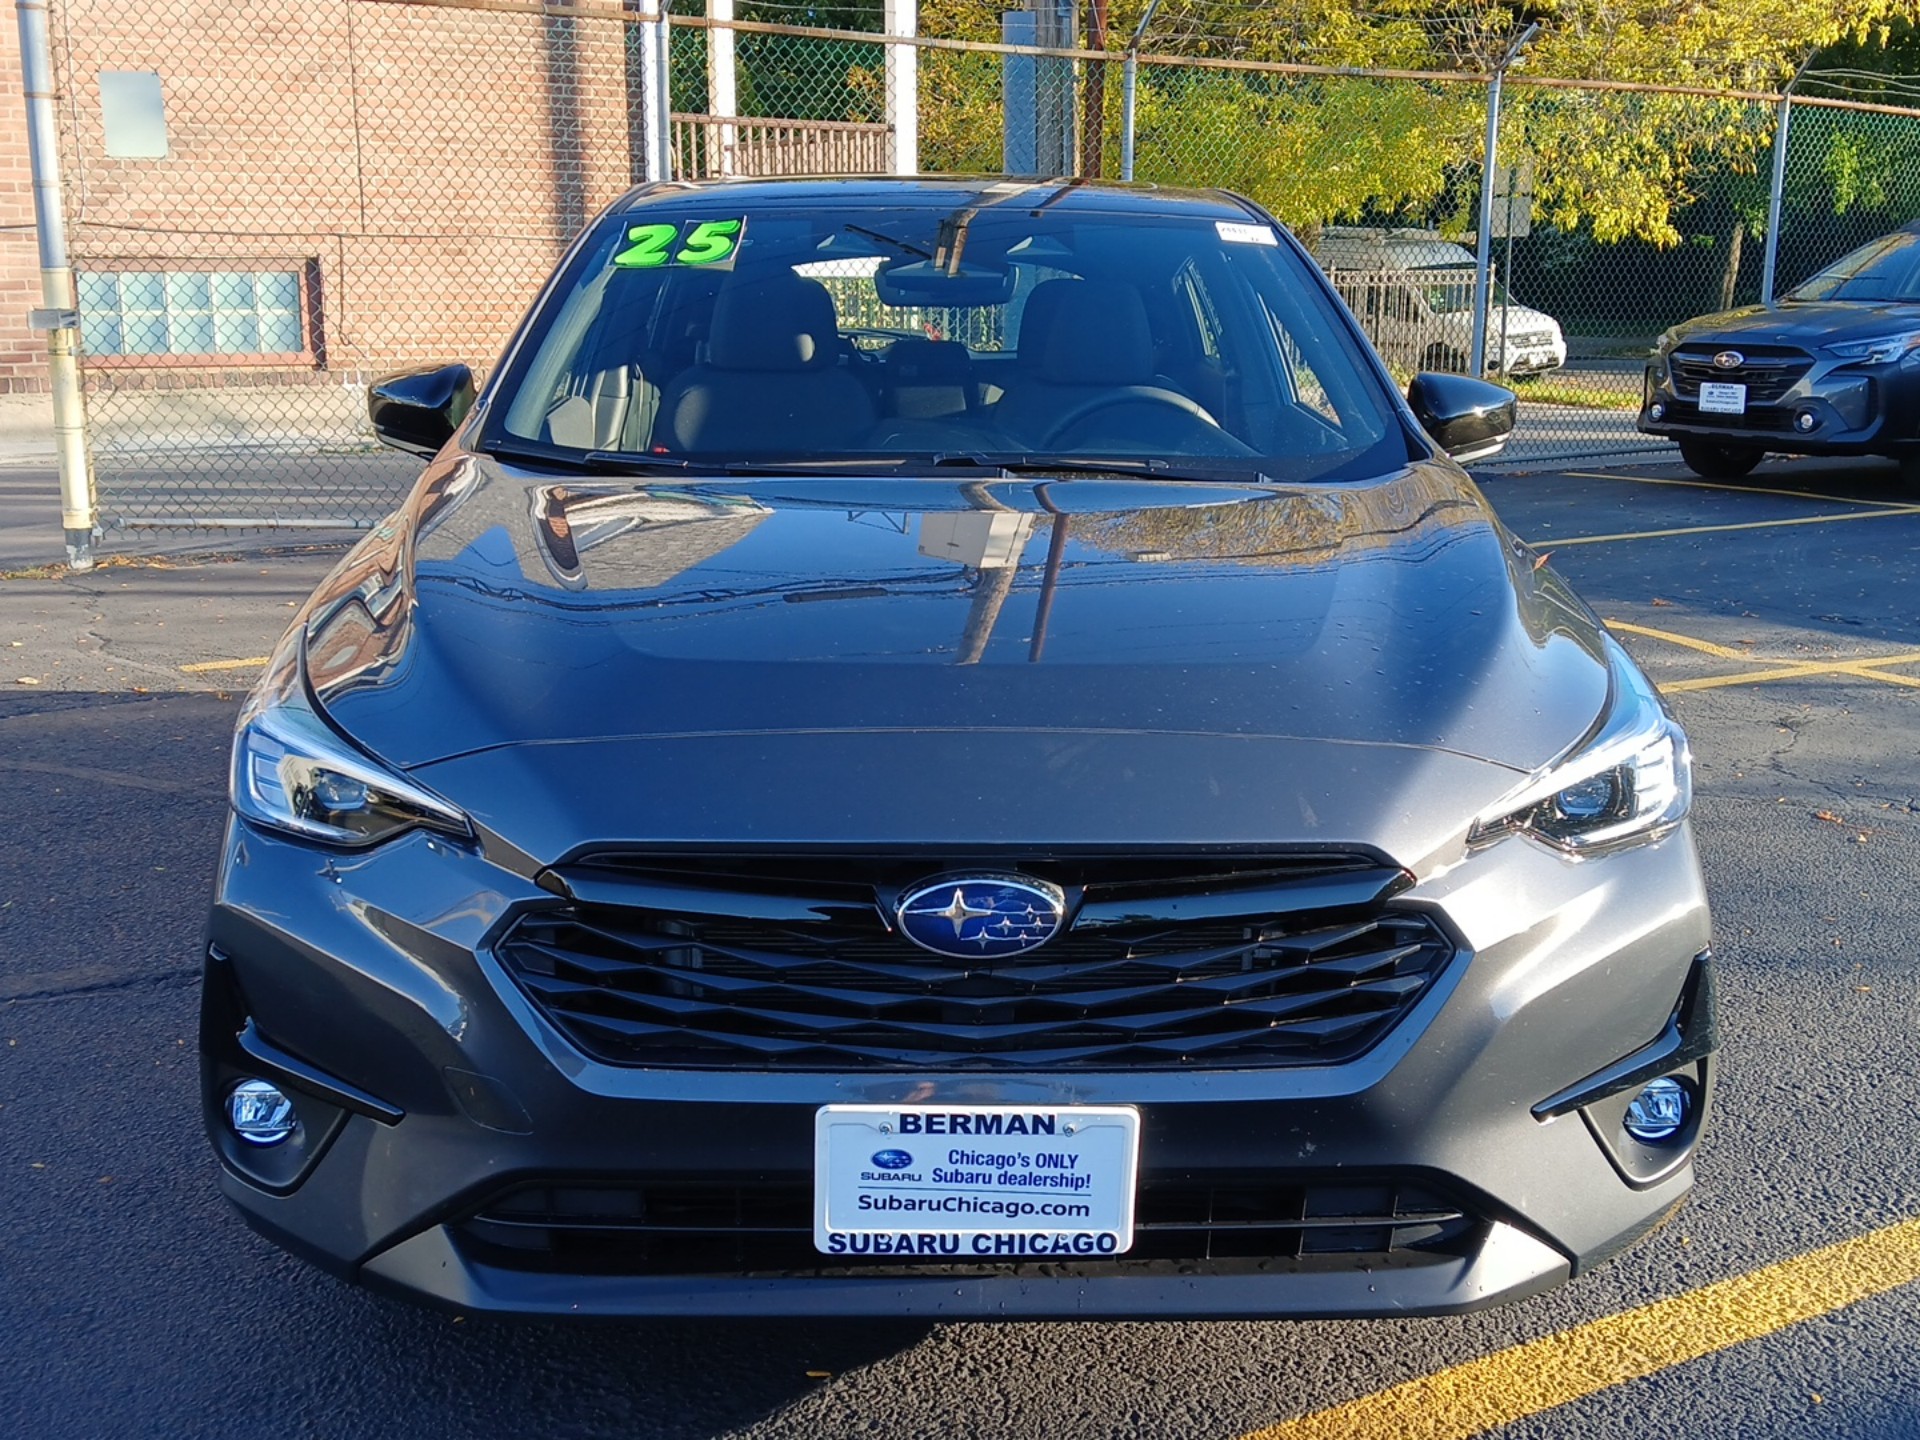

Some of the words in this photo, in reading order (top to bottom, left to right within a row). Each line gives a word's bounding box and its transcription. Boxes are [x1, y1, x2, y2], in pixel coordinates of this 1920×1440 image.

[614, 220, 740, 265] 25
[899, 1113, 1056, 1135] BERMAN
[948, 1149, 1030, 1169] Chicago's
[1035, 1152, 1079, 1169] ONLY
[860, 1171, 922, 1182] SUBARU
[931, 1168, 992, 1186] Subaru
[997, 1171, 1091, 1191] dealership!
[857, 1194, 1090, 1218] SubaruChicago.com
[827, 1232, 960, 1254] SUBARU
[971, 1232, 1118, 1254] CHICAGO
